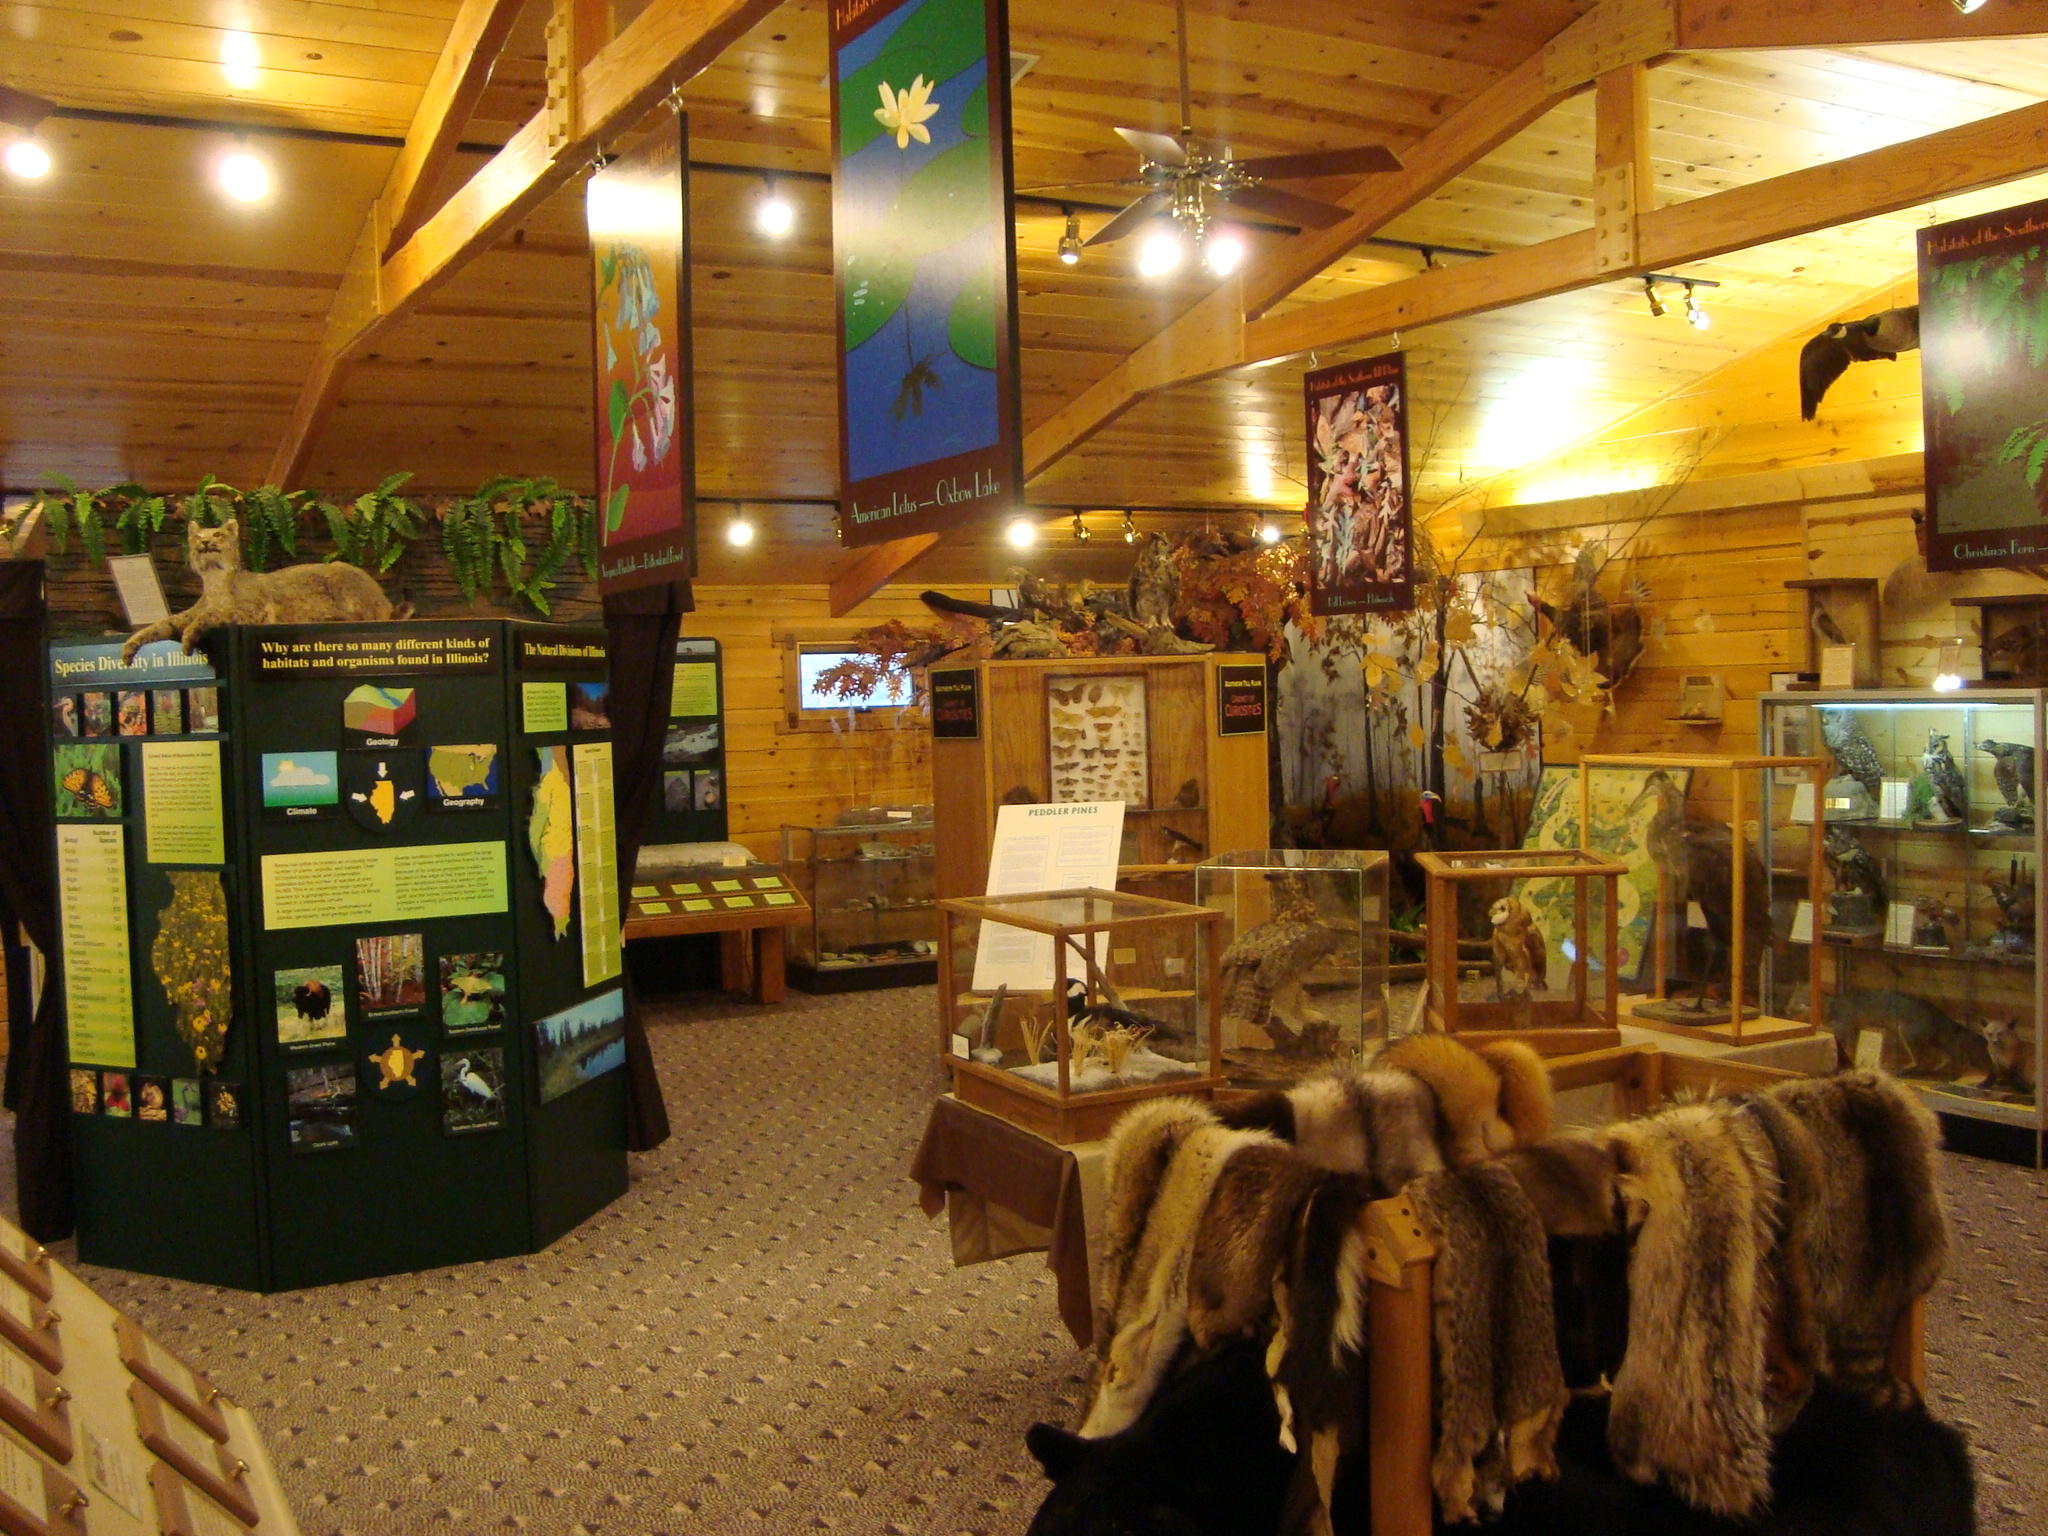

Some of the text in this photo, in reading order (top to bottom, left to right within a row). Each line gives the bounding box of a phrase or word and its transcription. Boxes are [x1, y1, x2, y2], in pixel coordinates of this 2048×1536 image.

[1984, 227, 2000, 242] the
[851, 501, 891, 524] American
[893, 492, 917, 516] Lotus
[937, 478, 973, 506] Oxbow
[975, 468, 1000, 498] Lake
[1953, 544, 2007, 559] Christmas
[2010, 539, 2035, 555] Fern
[261, 638, 490, 655] Why are there so many different kinds of
[524, 643, 536, 655] The
[536, 643, 558, 656] Natural
[55, 658, 96, 677] Species
[152, 653, 164, 667] in
[167, 650, 209, 666] Illinois
[262, 652, 489, 669] habitats and organisms found in Illinois?
[366, 738, 399, 747] Geology
[443, 798, 484, 807] Geography
[286, 807, 317, 816] Climate
[1028, 806, 1098, 817] PEDDLER PINES
